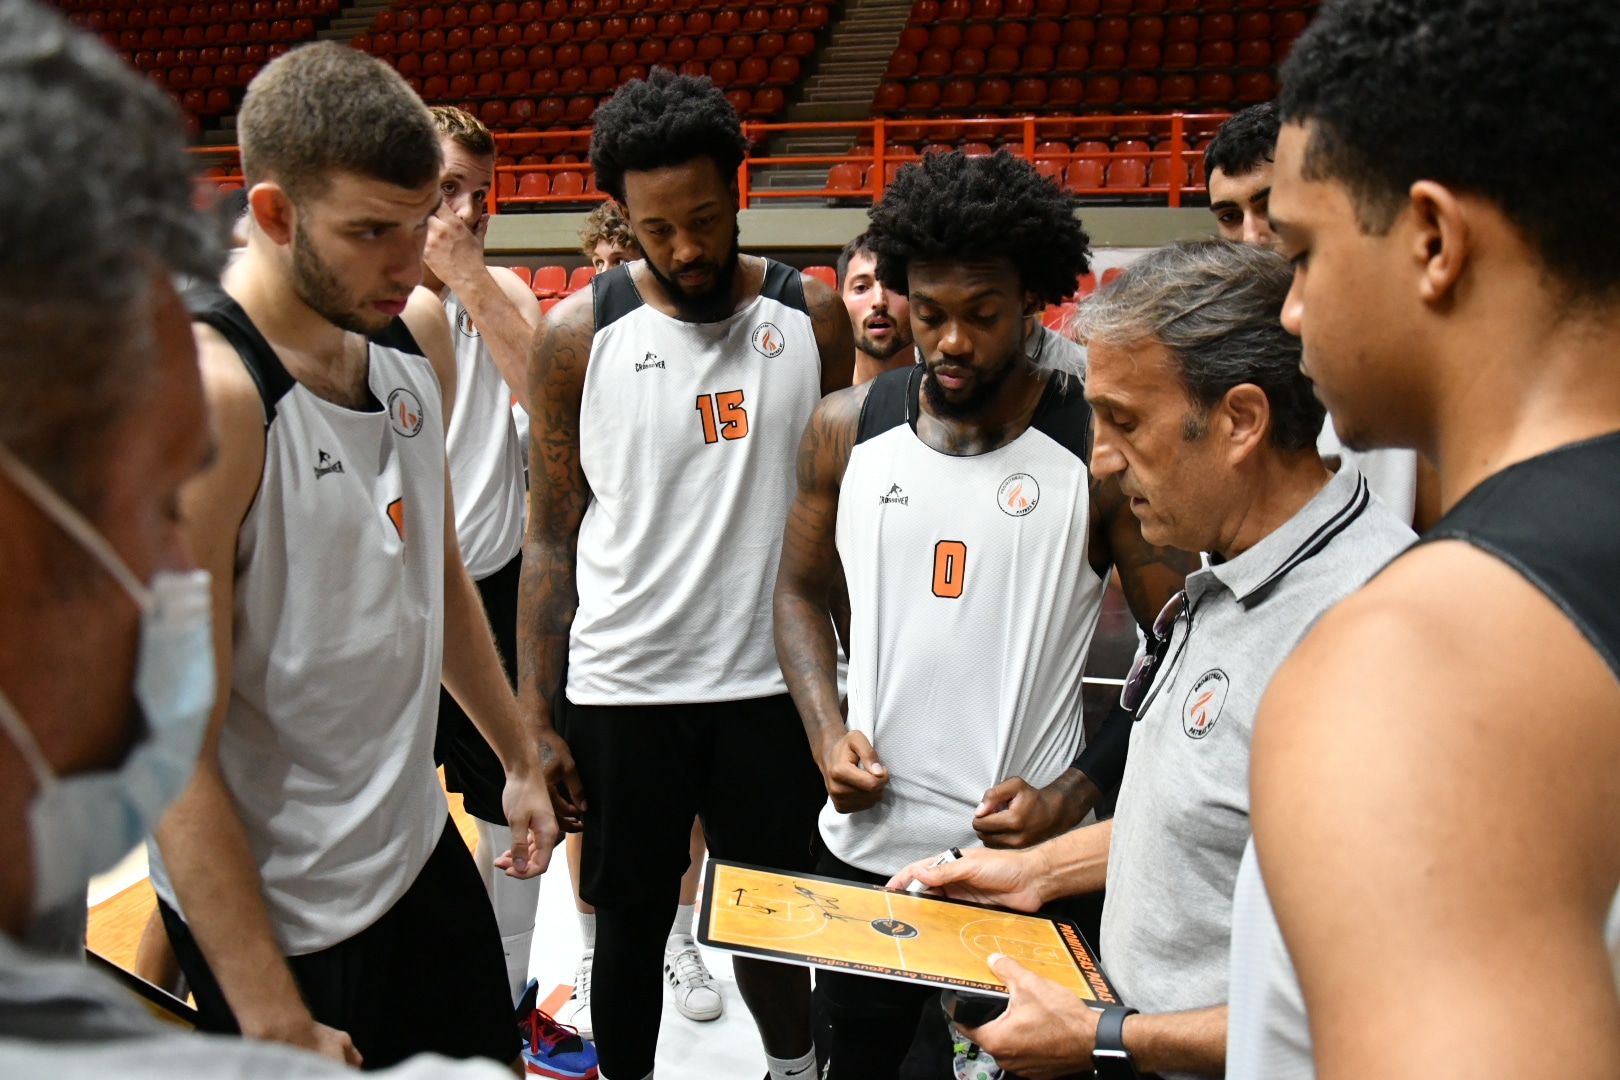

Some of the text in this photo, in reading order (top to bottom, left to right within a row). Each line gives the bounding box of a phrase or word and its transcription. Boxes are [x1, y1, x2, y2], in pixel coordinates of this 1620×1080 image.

[696, 389, 749, 444] 15
[931, 539, 967, 599] 0
[1057, 922, 1117, 1004] PROMITHEAS PATRAS
